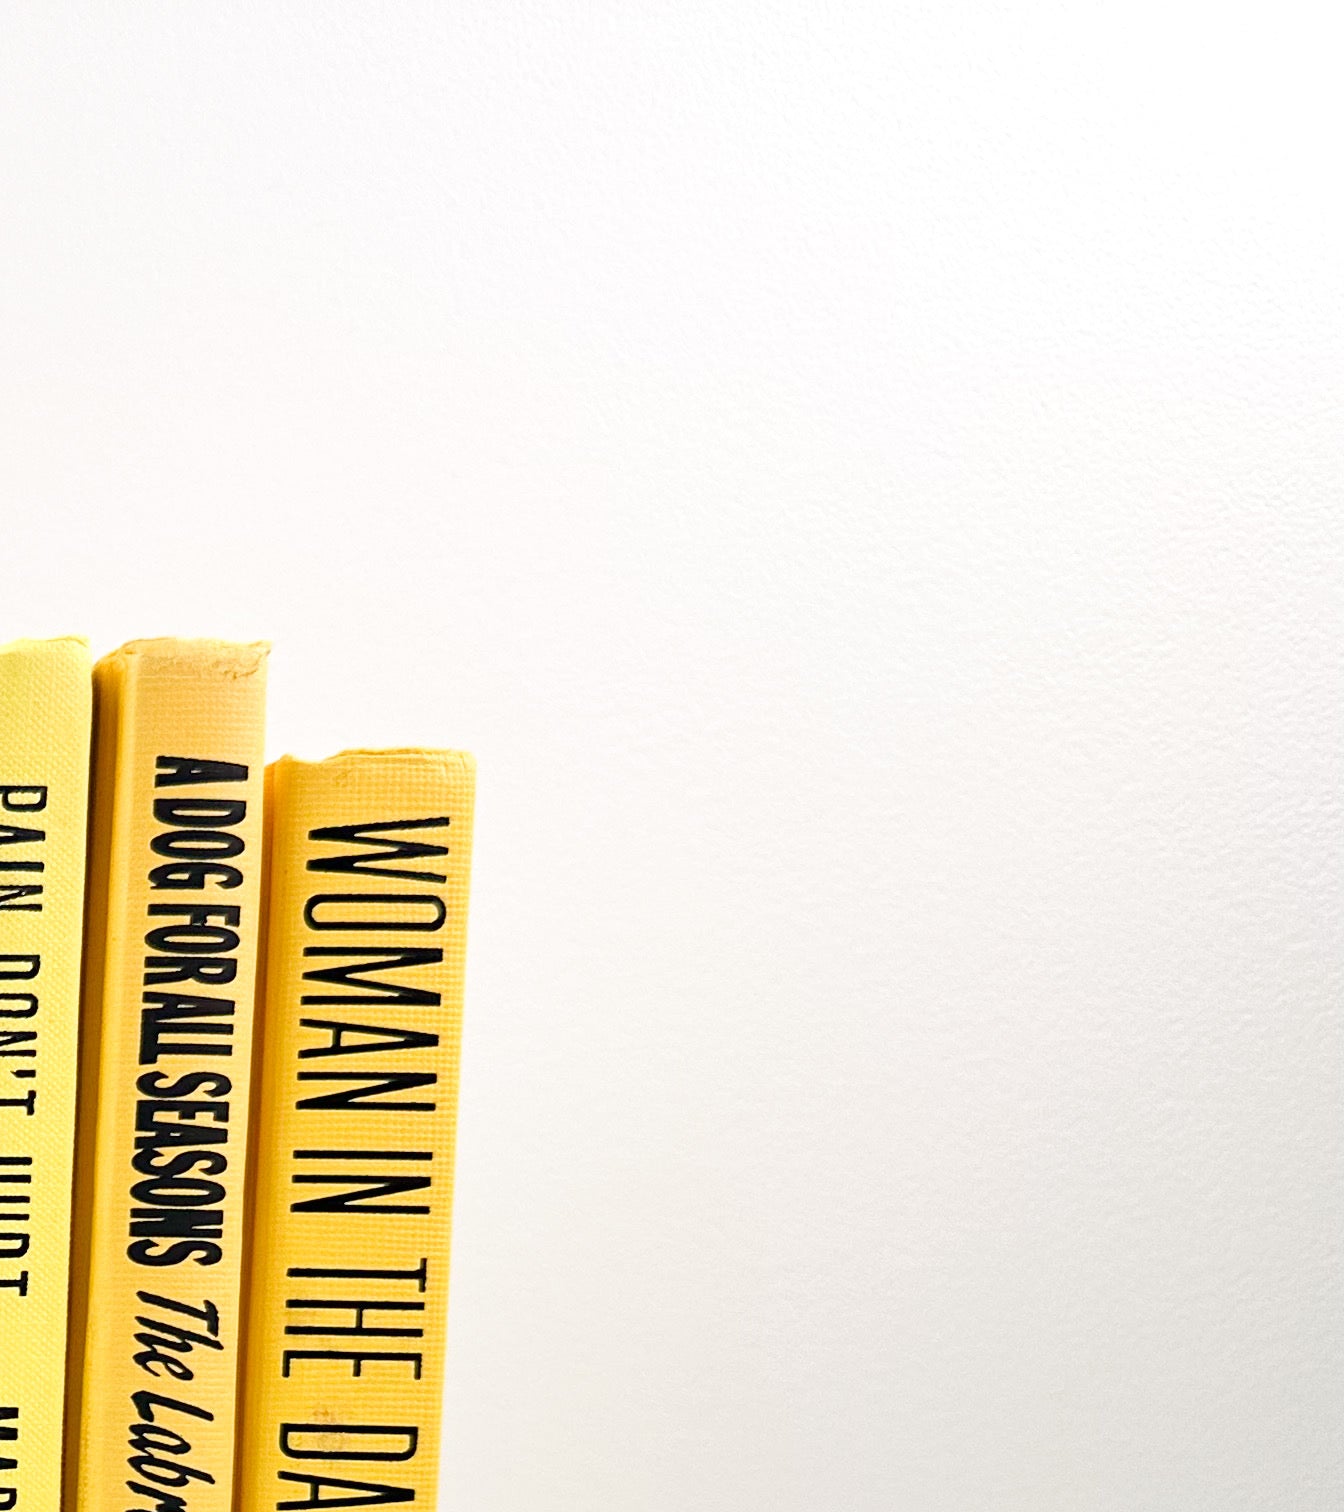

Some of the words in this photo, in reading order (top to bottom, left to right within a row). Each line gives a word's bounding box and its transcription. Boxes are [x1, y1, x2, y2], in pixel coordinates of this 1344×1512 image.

[154, 755, 249, 788] A
[147, 797, 247, 890] DOG
[142, 903, 242, 987] FOR
[295, 816, 451, 1112] WOMAN
[138, 991, 236, 1066] ALL
[126, 1070, 233, 1267] SEASONS
[290, 1149, 434, 1215] IN
[132, 1290, 225, 1381] The
[281, 1257, 428, 1381] THE
